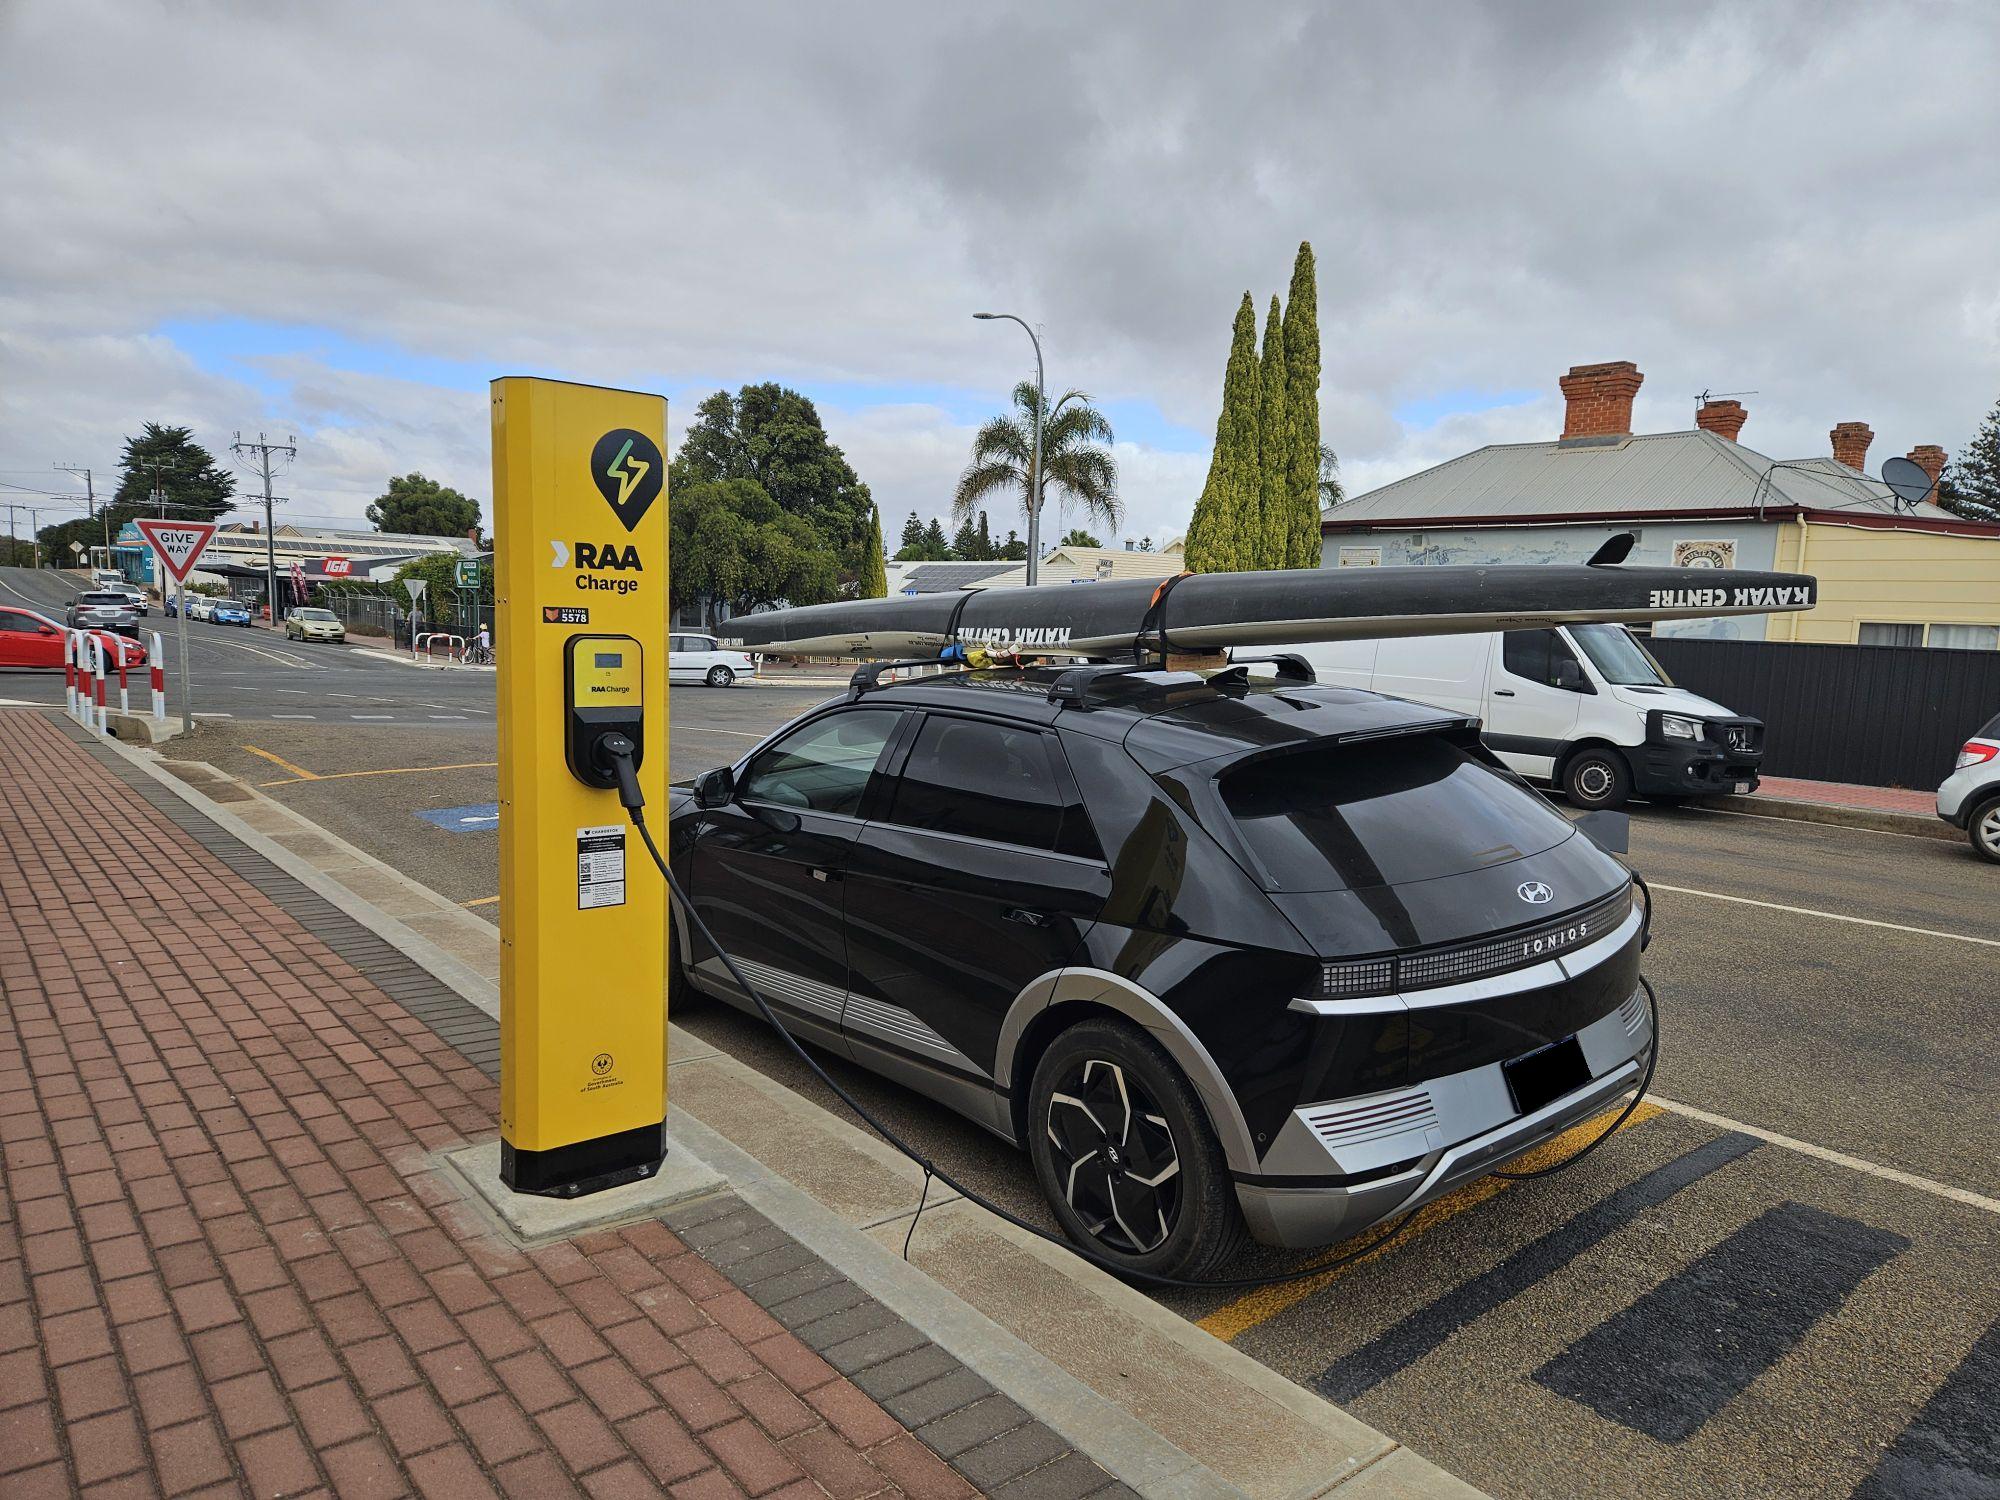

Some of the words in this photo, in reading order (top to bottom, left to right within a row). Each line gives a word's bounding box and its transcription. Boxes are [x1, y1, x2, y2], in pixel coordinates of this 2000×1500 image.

[160, 532, 195, 544] GIVE
[167, 545, 189, 554] WAY
[575, 542, 643, 571] RAA
[325, 560, 349, 573] IGA
[575, 574, 638, 595] Charge
[1650, 588, 1727, 608] CENTRE
[1733, 586, 1810, 606] KAYAK
[561, 613, 587, 623] 5578
[606, 685, 630, 694] Charge
[1523, 928, 1577, 956] IONIQ
[1580, 922, 1587, 937] 5
